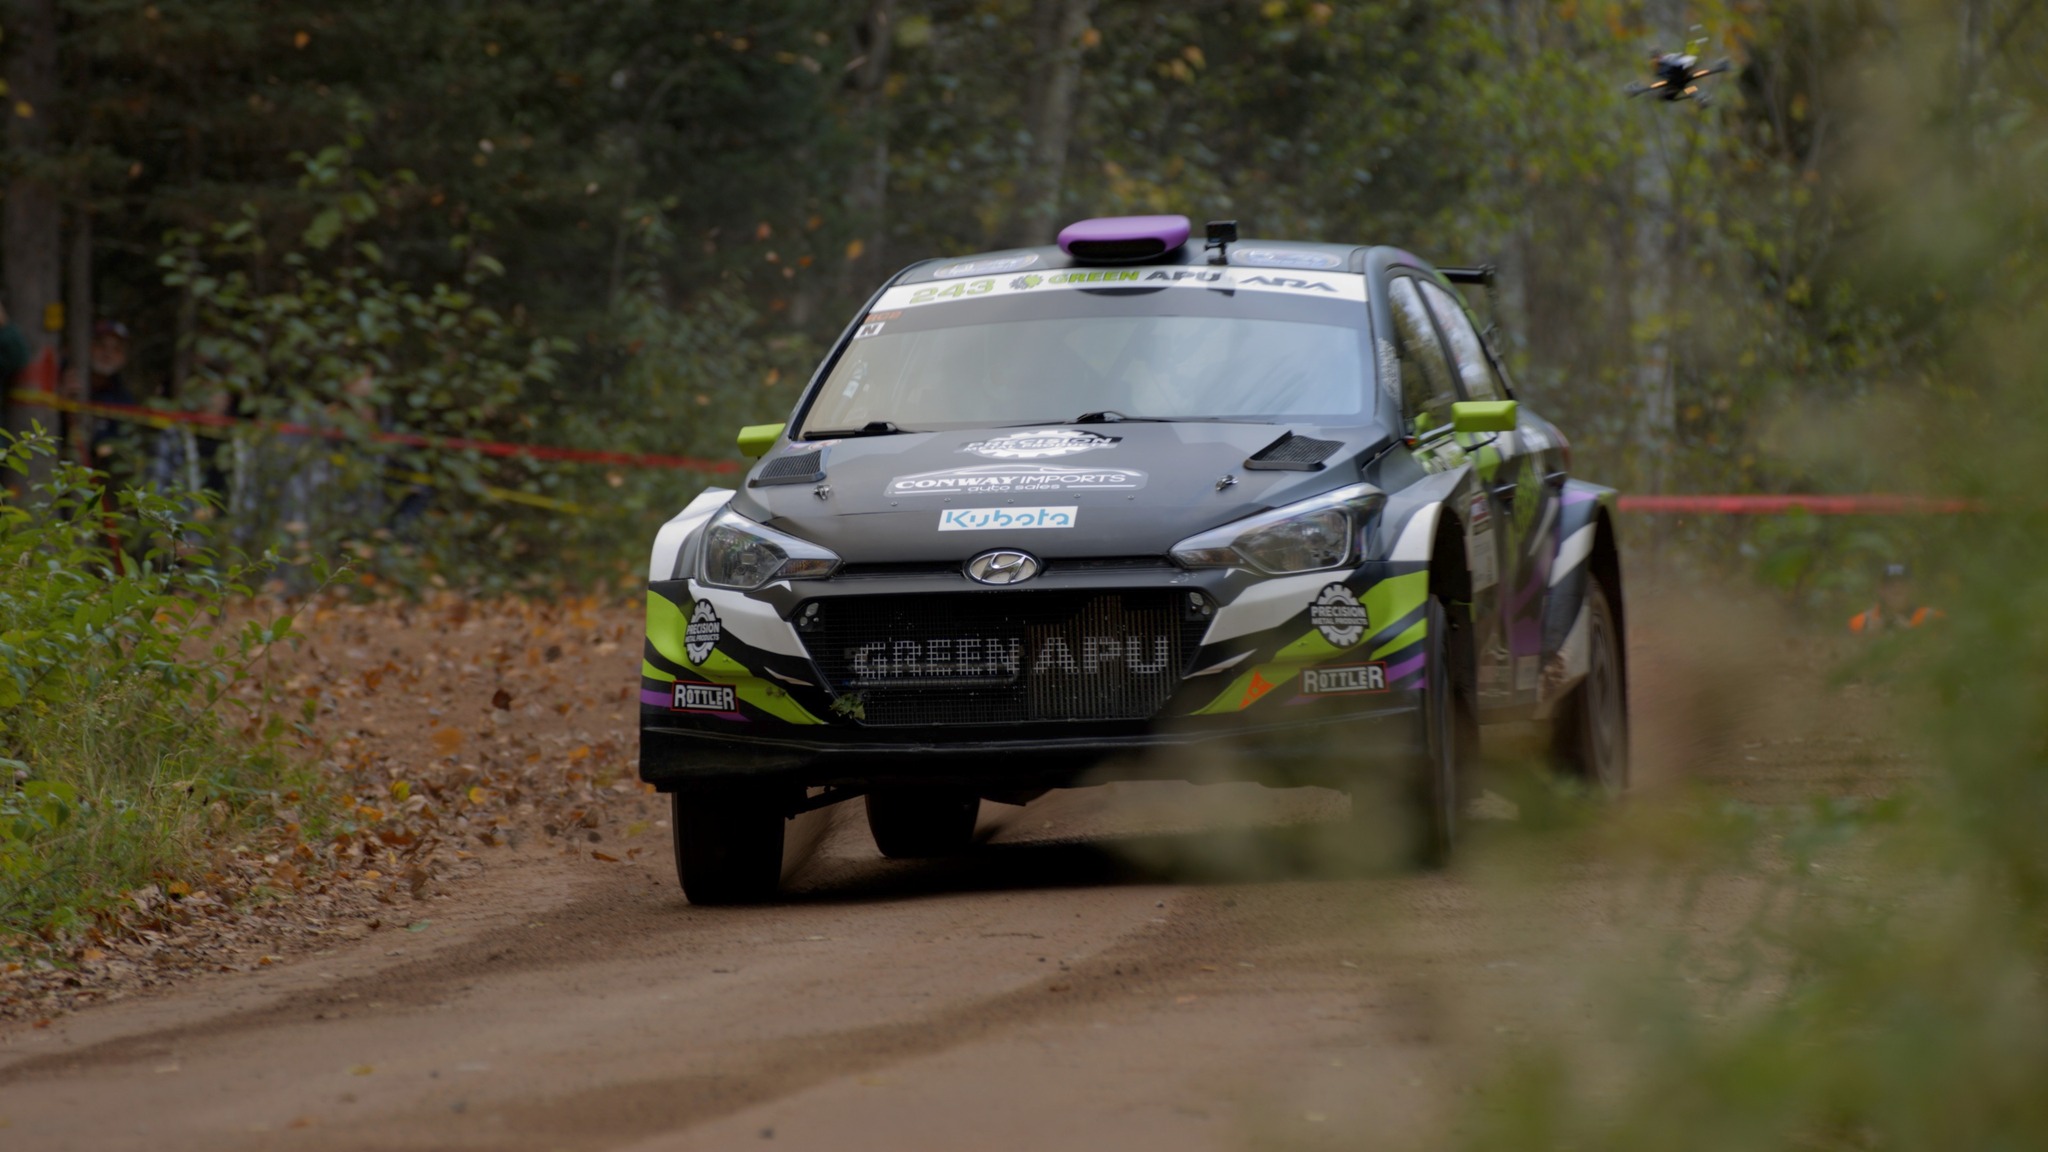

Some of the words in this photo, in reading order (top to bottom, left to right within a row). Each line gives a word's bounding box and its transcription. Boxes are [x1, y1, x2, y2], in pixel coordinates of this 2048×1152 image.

[1049, 271, 1140, 284] GREEN
[1145, 270, 1222, 282] APU
[1239, 276, 1339, 292] ARA
[909, 278, 997, 304] 243
[968, 437, 1113, 448] PRECISION
[895, 475, 1018, 489] CONWAY
[1019, 474, 1128, 485] IMPORTS
[967, 484, 1011, 493] auto
[1014, 483, 1061, 491] sales
[945, 508, 1070, 528] Kubota
[1310, 605, 1367, 618] PRECISION
[687, 622, 720, 635] PRECISION
[1311, 617, 1335, 625] METAL
[854, 638, 1020, 680] GREEN
[1033, 636, 1169, 674] APU
[1303, 665, 1385, 693] ROTTLER
[674, 685, 735, 710] ROTTLER
